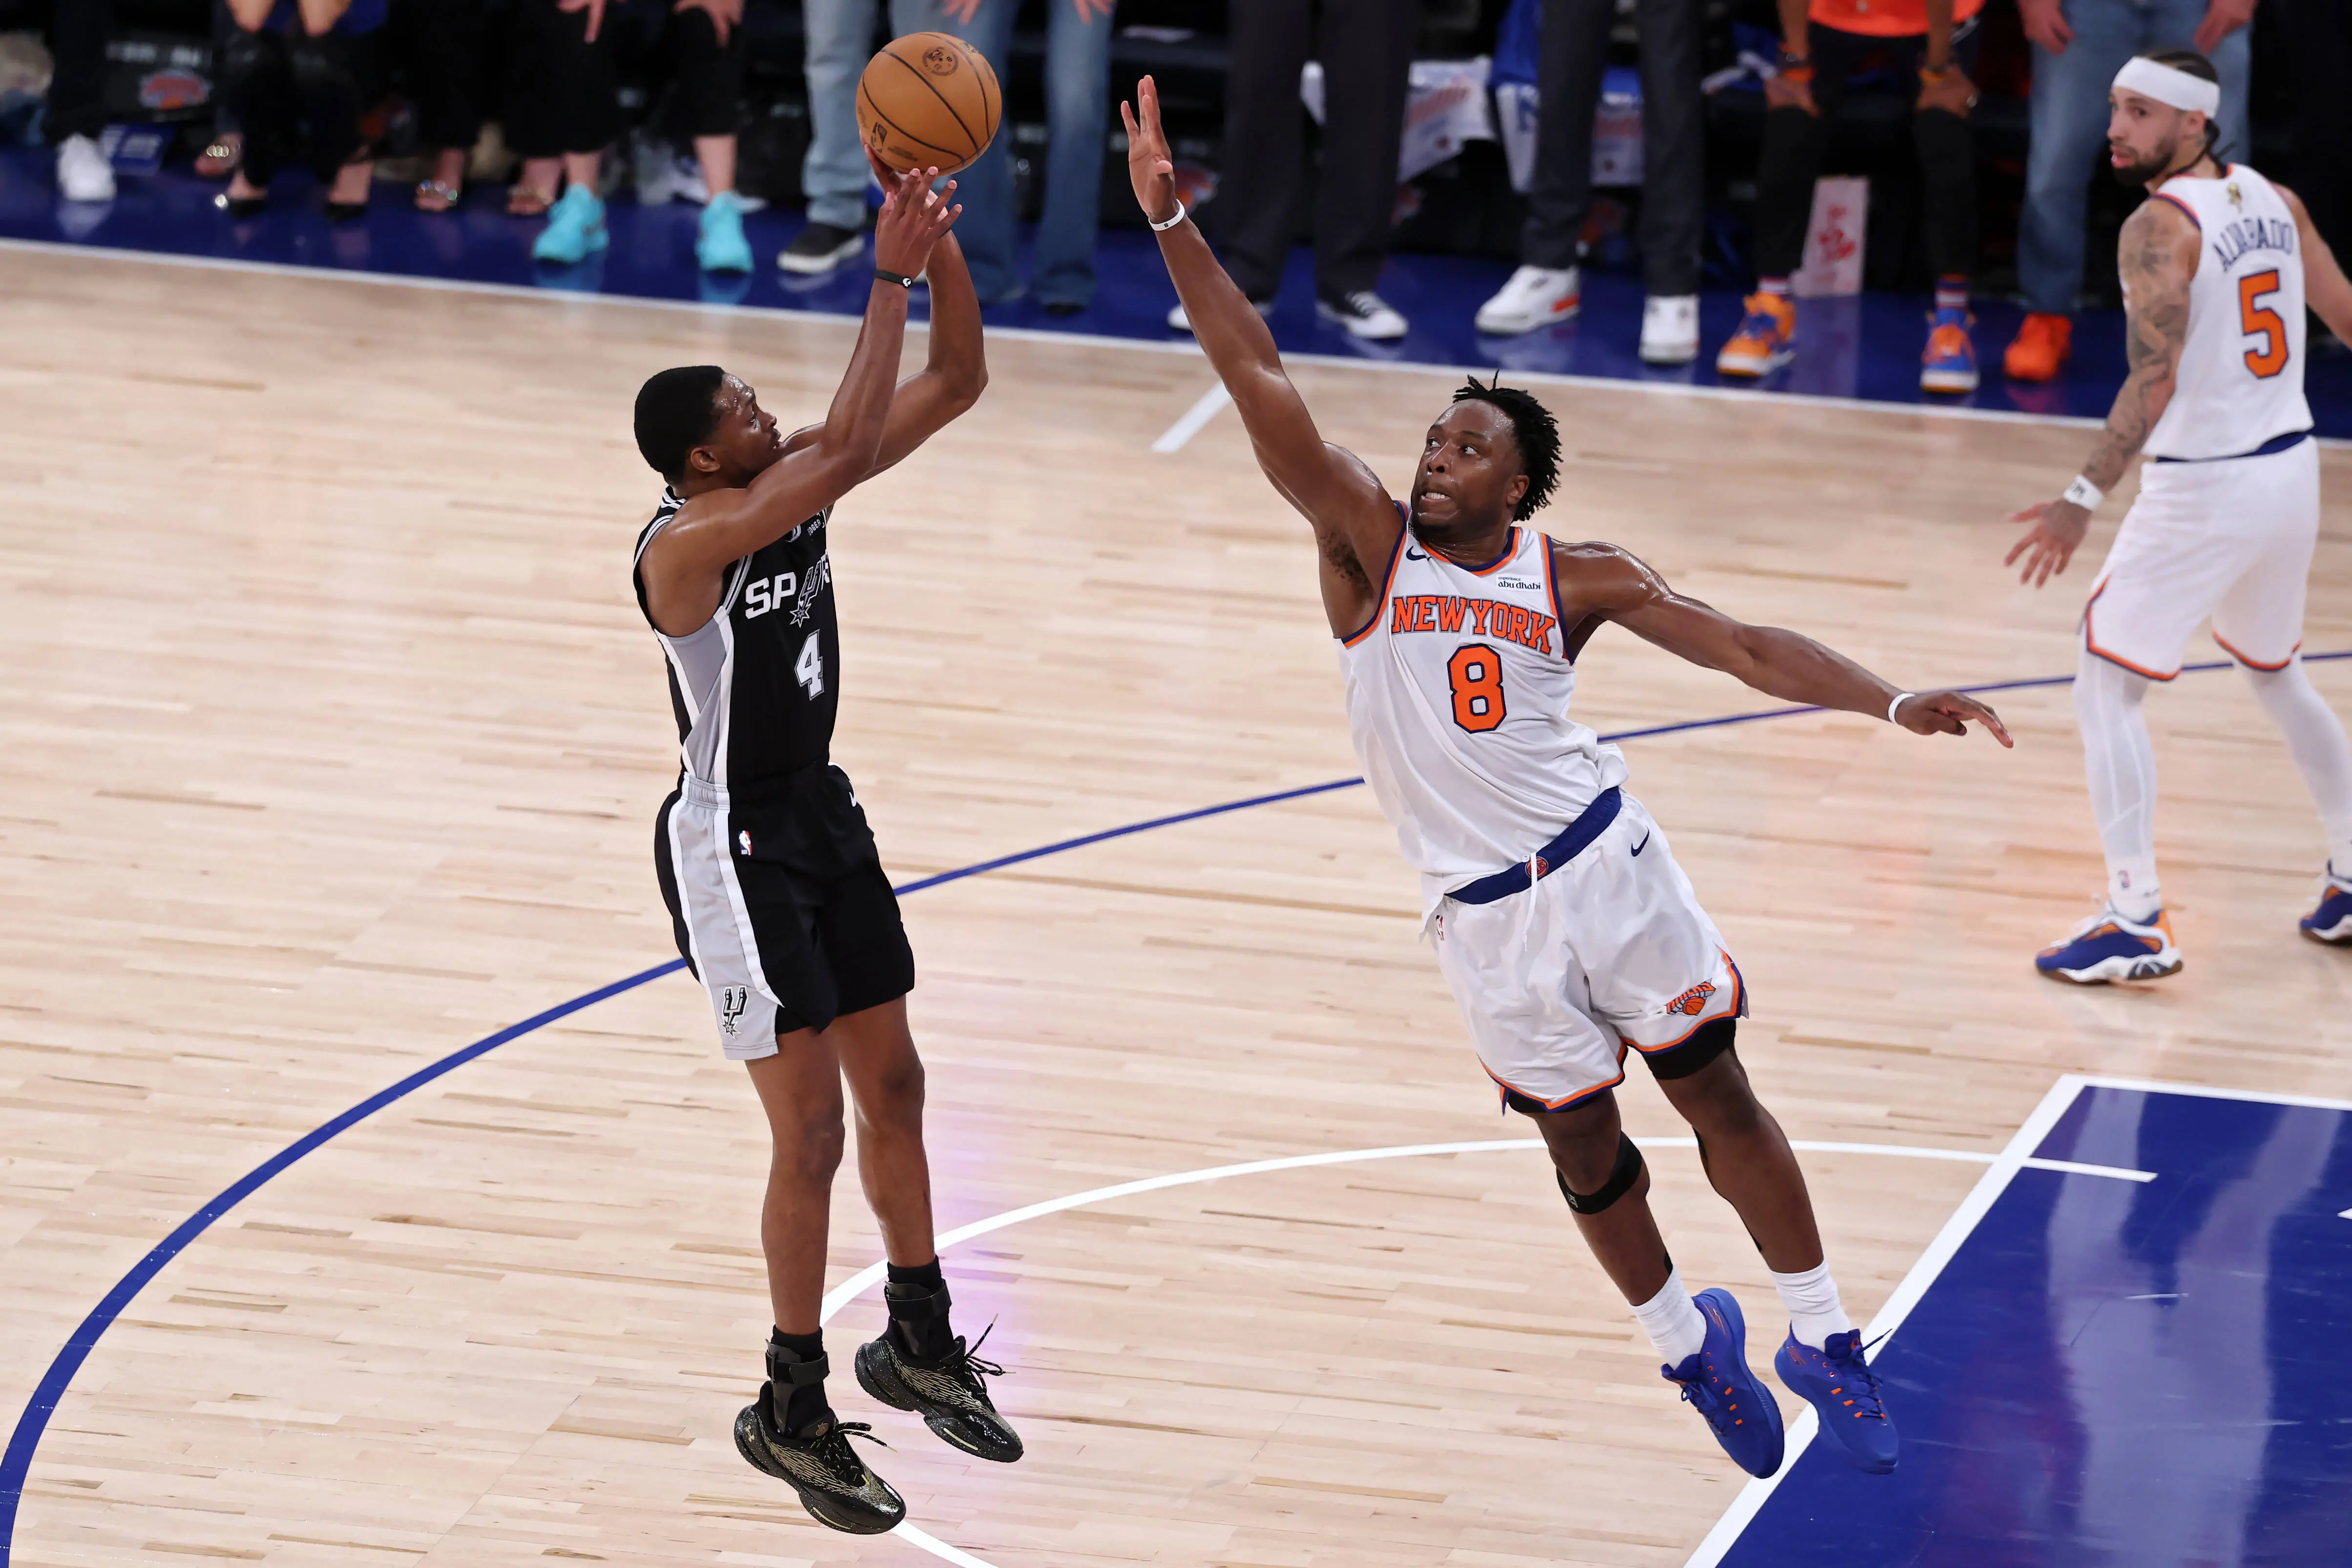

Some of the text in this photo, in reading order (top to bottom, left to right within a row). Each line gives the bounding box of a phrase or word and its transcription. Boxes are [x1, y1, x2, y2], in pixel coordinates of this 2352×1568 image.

[2213, 217, 2293, 272] ALVARADO
[2240, 268, 2289, 379] 5
[1516, 582, 1540, 590] dhabi
[1392, 594, 1558, 656] NEW YORK
[794, 629, 824, 700] 4
[1447, 644, 1507, 734] 8
